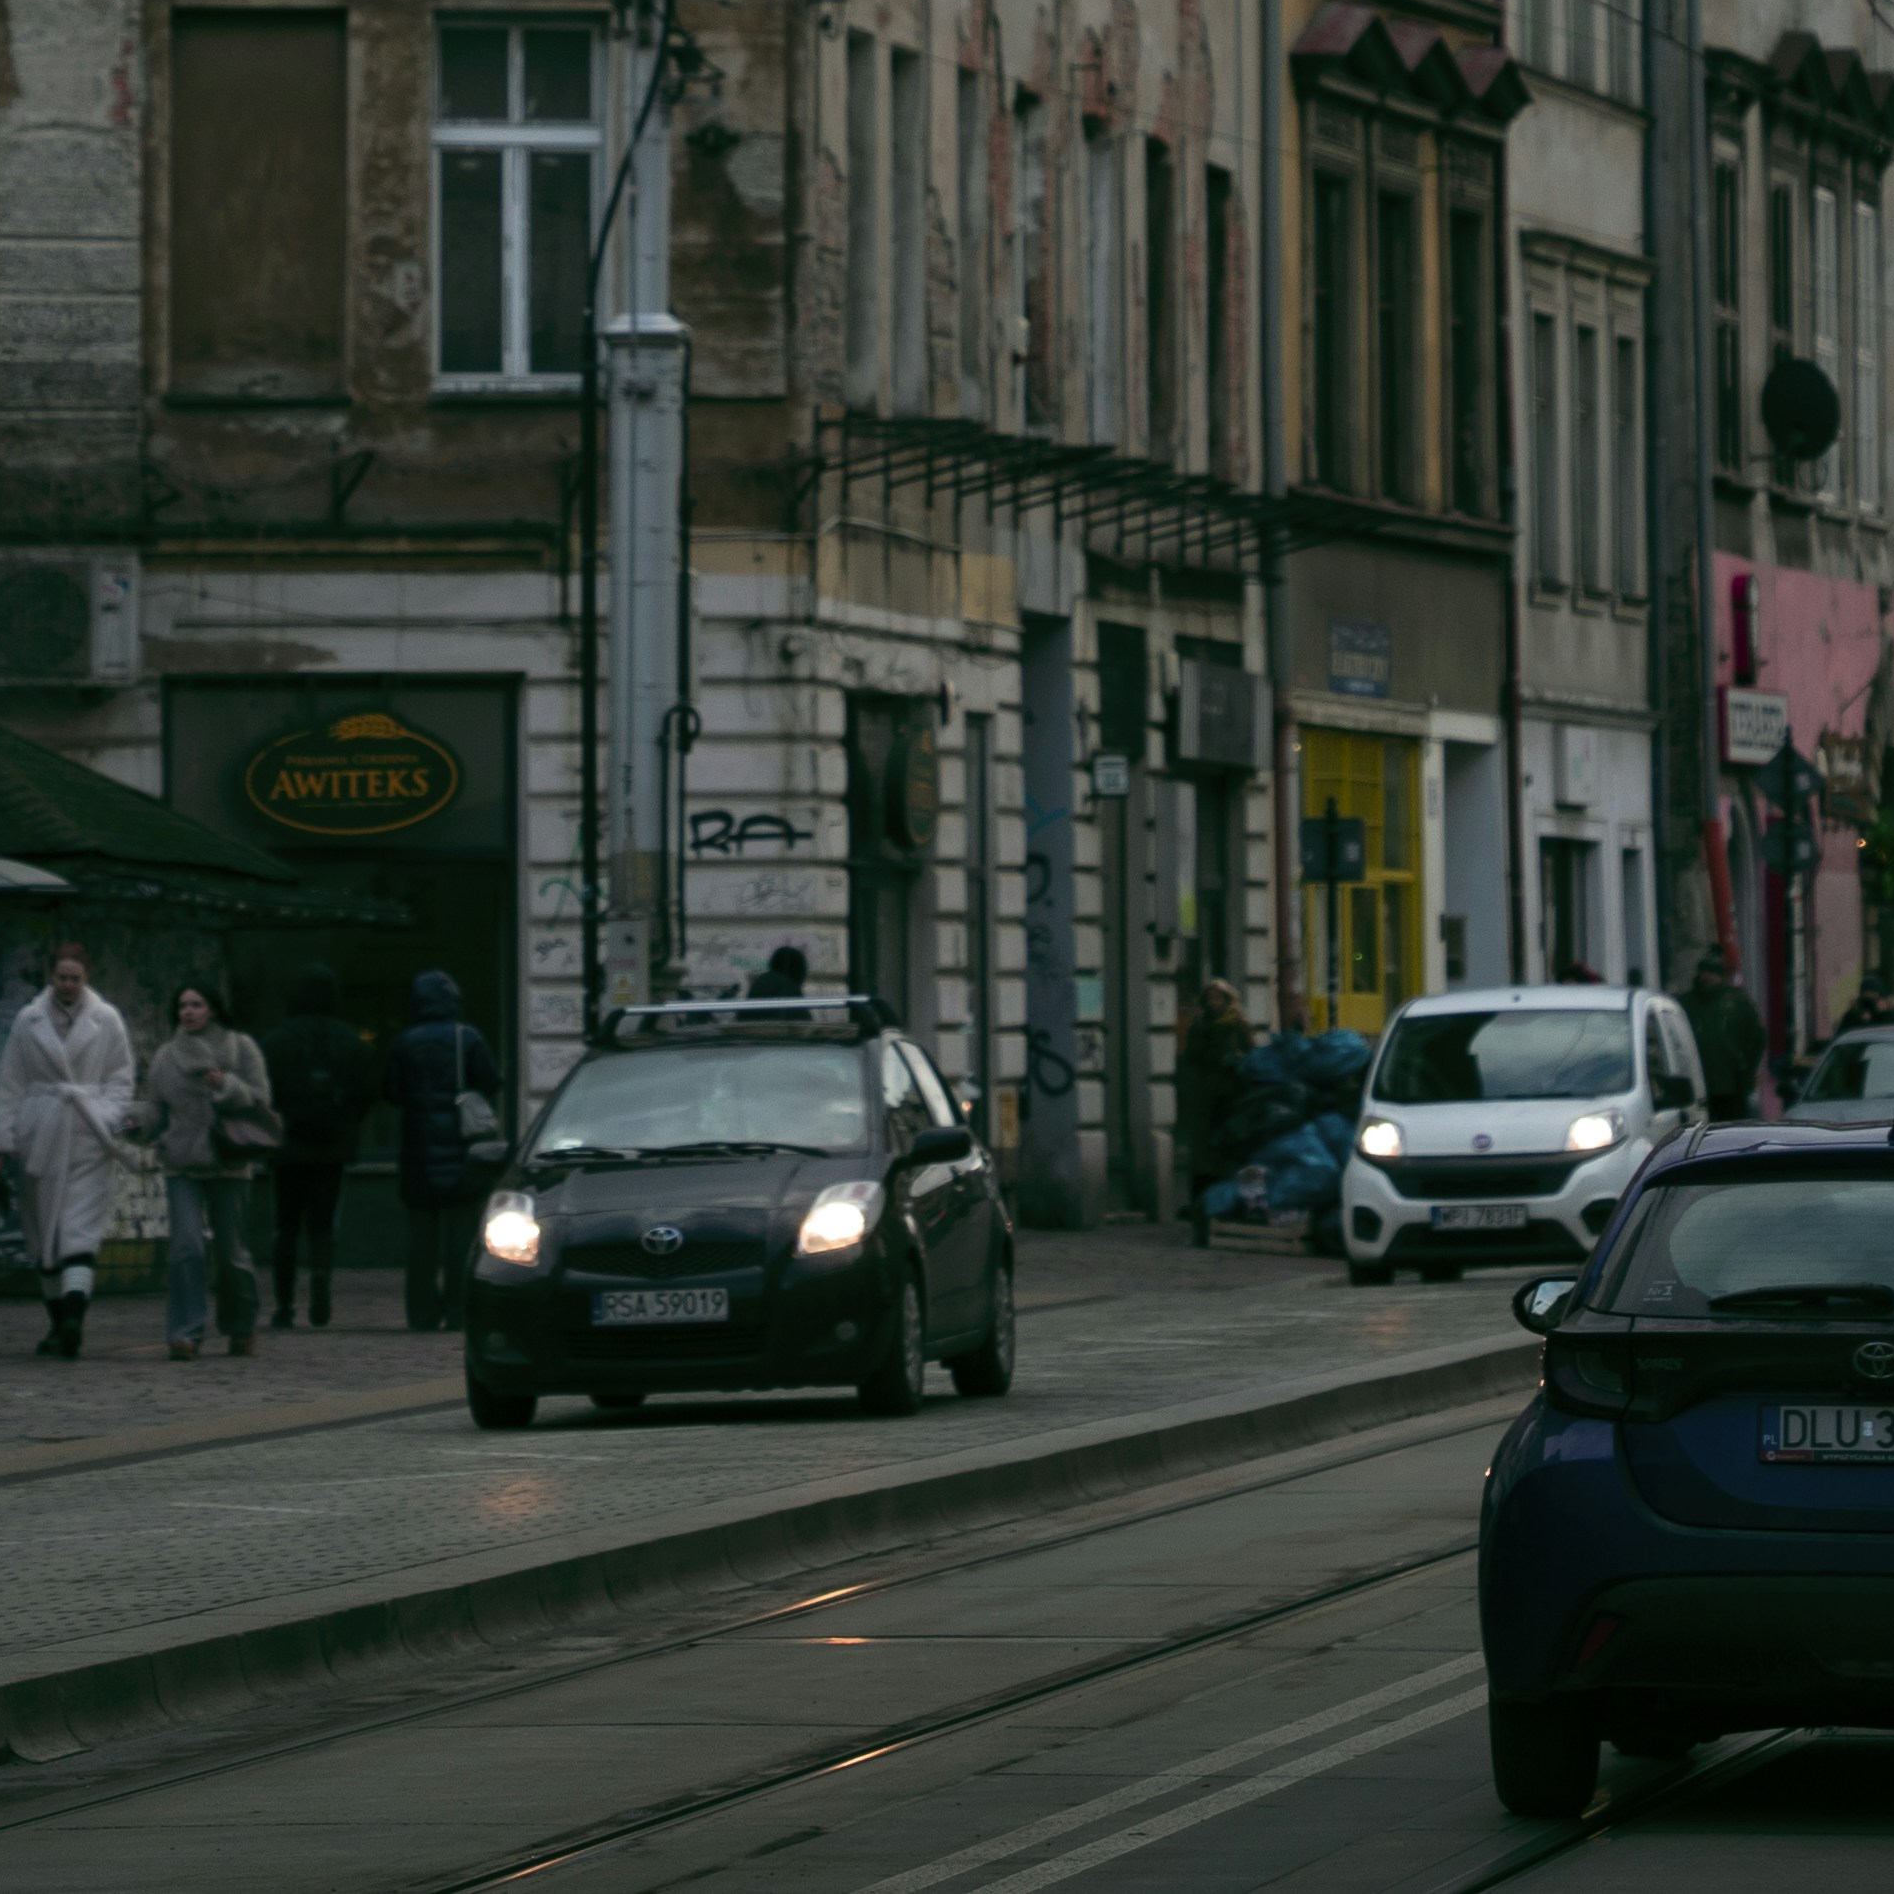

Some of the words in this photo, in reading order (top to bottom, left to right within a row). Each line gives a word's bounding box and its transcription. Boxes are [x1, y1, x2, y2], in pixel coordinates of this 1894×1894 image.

[270, 768, 430, 800] AWITEKS
[1762, 1434, 1778, 1446] PL
[1783, 1409, 1861, 1448] DLU
